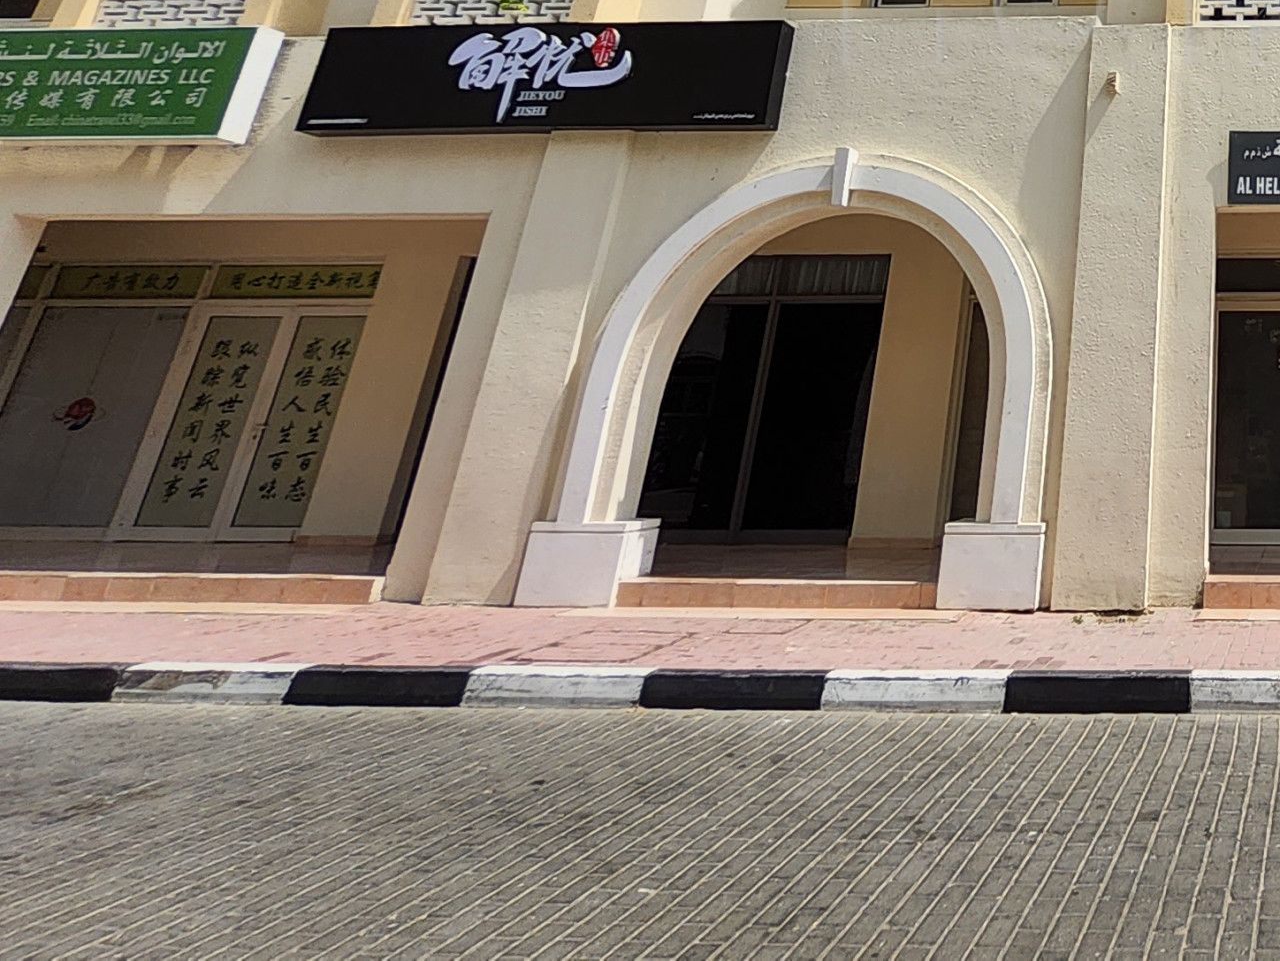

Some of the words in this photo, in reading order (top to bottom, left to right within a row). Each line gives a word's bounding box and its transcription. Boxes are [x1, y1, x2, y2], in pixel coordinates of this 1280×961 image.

[22, 70, 39, 86] &
[47, 69, 171, 86] MAGAZINES
[178, 68, 215, 84] LLC
[517, 90, 566, 101] JIEYOU
[1237, 177, 1252, 194] AL
